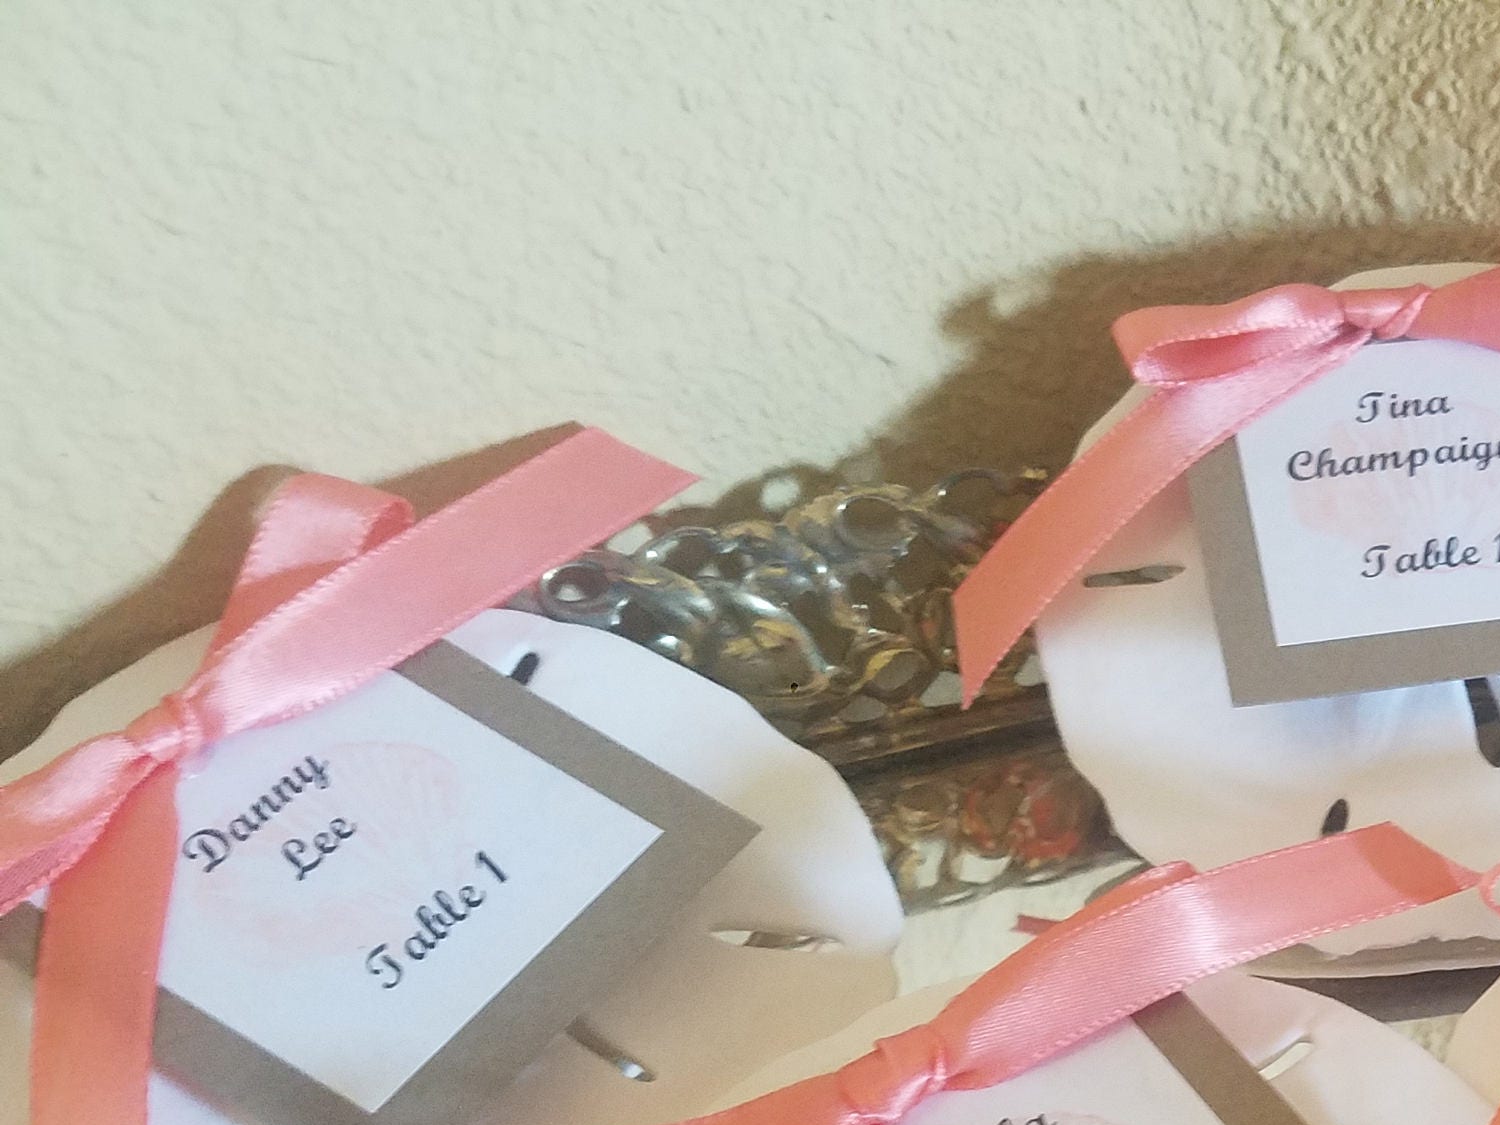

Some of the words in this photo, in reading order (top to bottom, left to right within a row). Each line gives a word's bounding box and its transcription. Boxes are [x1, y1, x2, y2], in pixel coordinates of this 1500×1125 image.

[1356, 392, 1452, 423] Tina
[1361, 537, 1480, 578] Table
[183, 755, 330, 873] Danny
[282, 817, 357, 880] Lee
[365, 885, 486, 988] Table
[475, 850, 508, 882] 1
